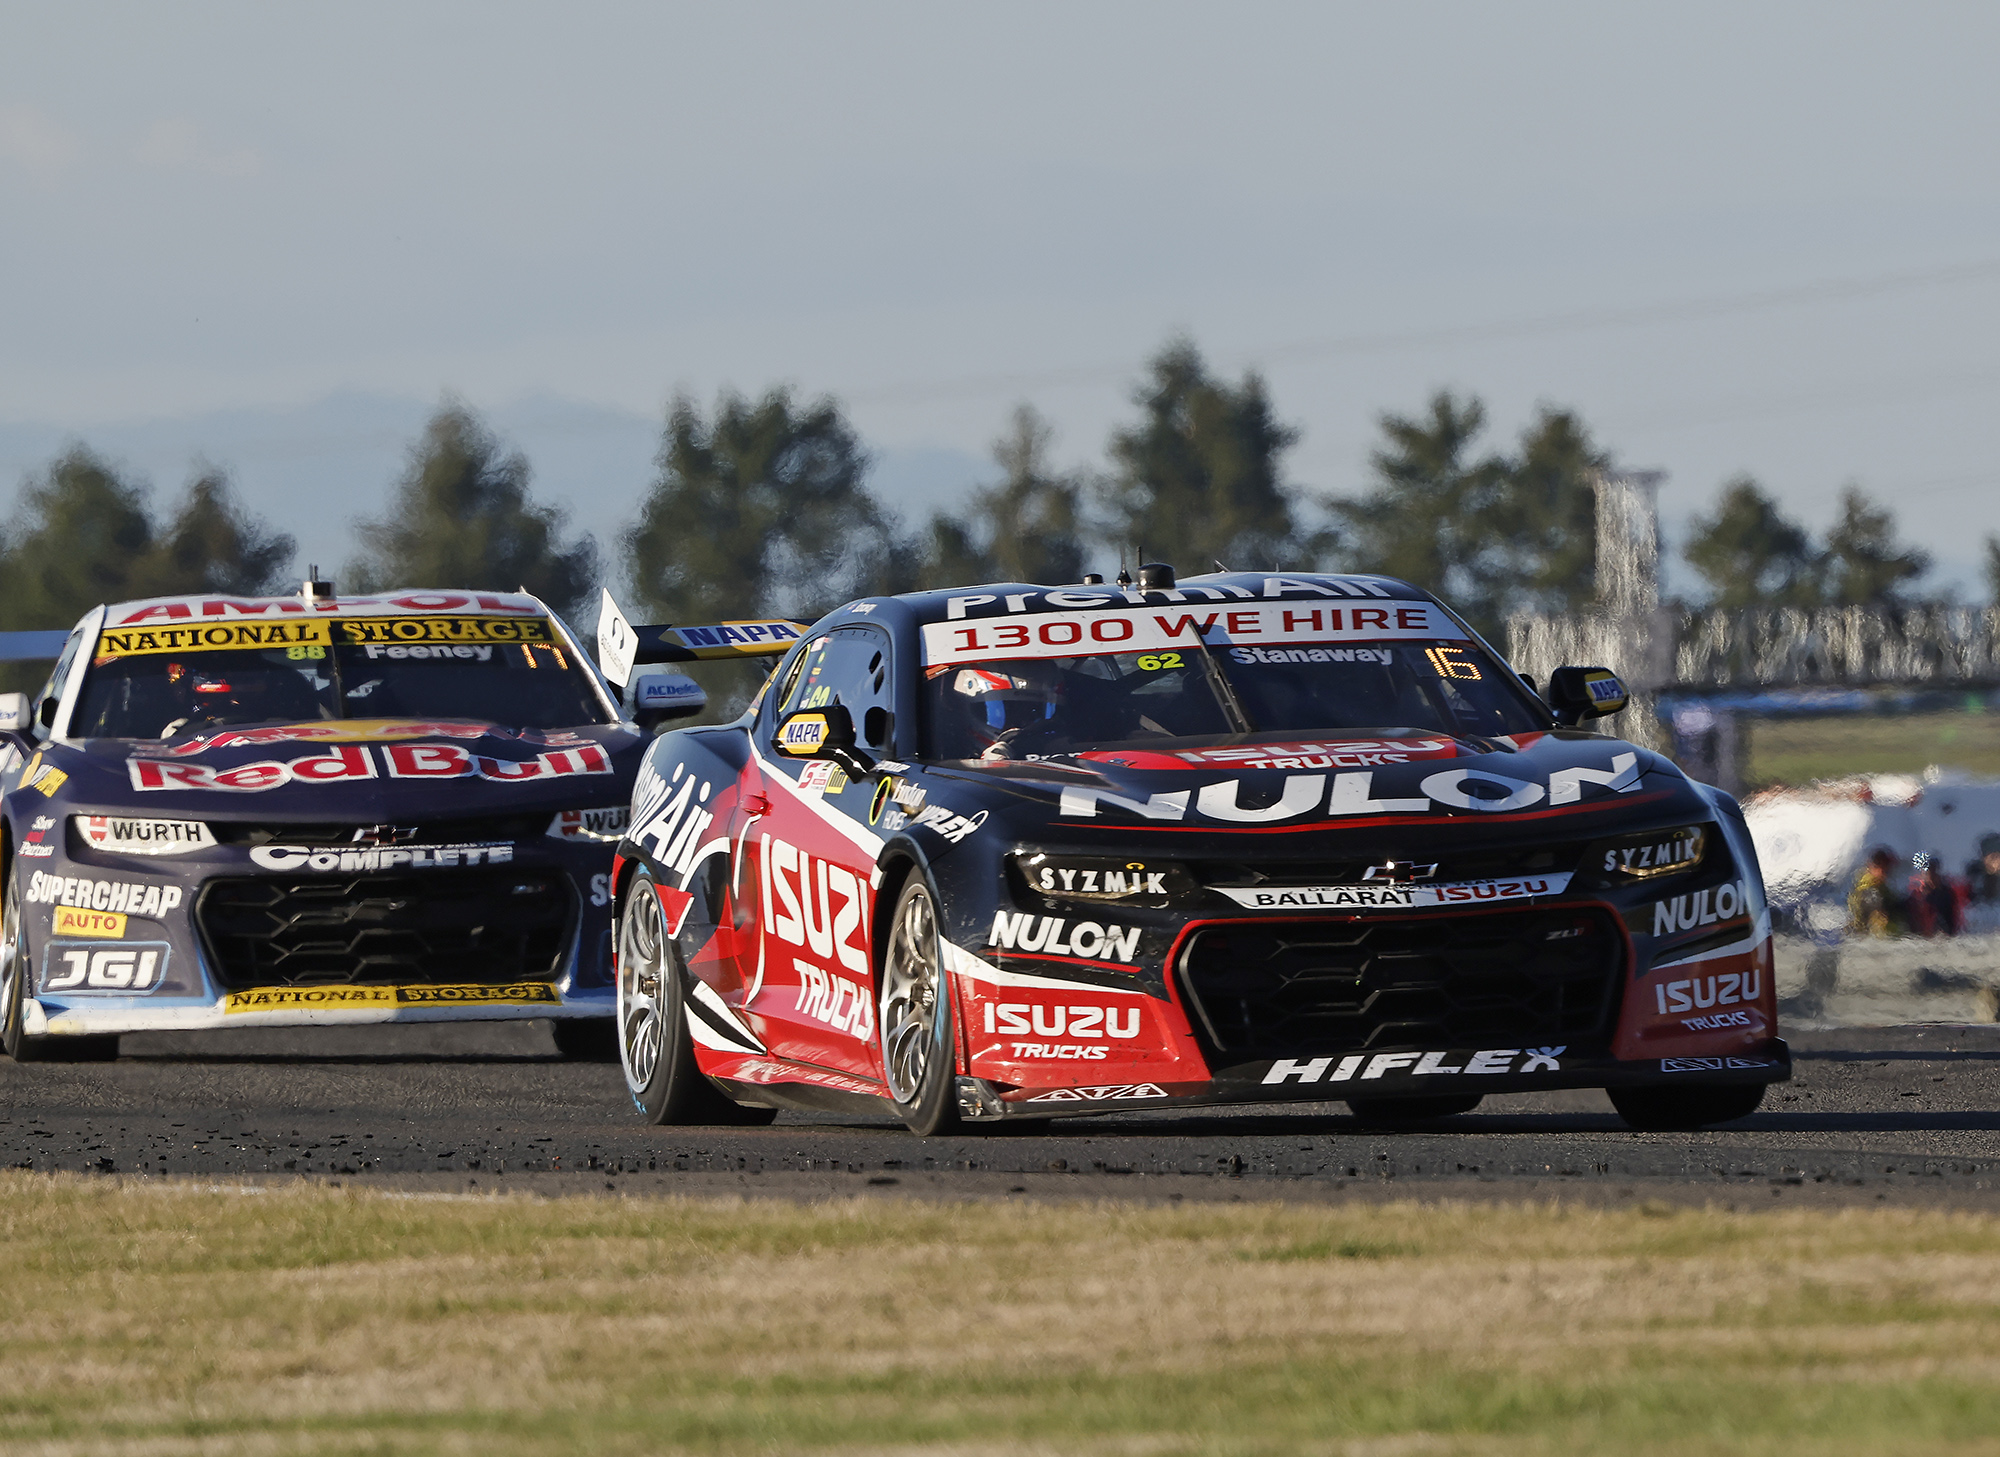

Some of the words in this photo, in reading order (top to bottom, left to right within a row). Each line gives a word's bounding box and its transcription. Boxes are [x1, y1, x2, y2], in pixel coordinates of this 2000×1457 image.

[106, 624, 319, 652] NATIONAL
[342, 620, 545, 641] STORAGE
[682, 624, 800, 646] NAPA
[954, 618, 1134, 652] 1300
[1153, 611, 1263, 638] WE
[1283, 608, 1430, 632] HIRE
[286, 646, 327, 660] 88
[365, 643, 493, 662] Feeney
[1137, 653, 1185, 671] 62
[1231, 647, 1394, 666] Stanaway
[1425, 648, 1482, 680] 16
[786, 723, 821, 743] NAPA
[1182, 741, 1445, 762] ISUZU
[1244, 753, 1410, 769] TRUCKS
[126, 745, 379, 793] Red
[381, 743, 614, 782] Bull
[1060, 752, 1643, 822] NULON
[112, 820, 202, 842] WÜRTH
[1604, 838, 1696, 872] SYZMIK
[25, 870, 183, 919] SUPERCHEAP
[1040, 867, 1168, 895] SYZMIK
[1256, 890, 1415, 906] BALLARAT
[1436, 880, 1549, 902] ISUZU
[62, 913, 117, 930] AUTO
[987, 910, 1142, 963] NULON
[48, 951, 158, 989] JGI
[231, 989, 393, 1008] NATIONAL
[402, 985, 547, 1001] STORAGE
[793, 957, 875, 1042] TRUCKS
[1655, 969, 1761, 1015] ISUZU
[984, 1002, 1141, 1039] ISUZU
[1681, 1011, 1751, 1032] TRUCKS
[1011, 1042, 1109, 1060] TRUCKS
[1261, 1046, 1567, 1085] HIFLEX
